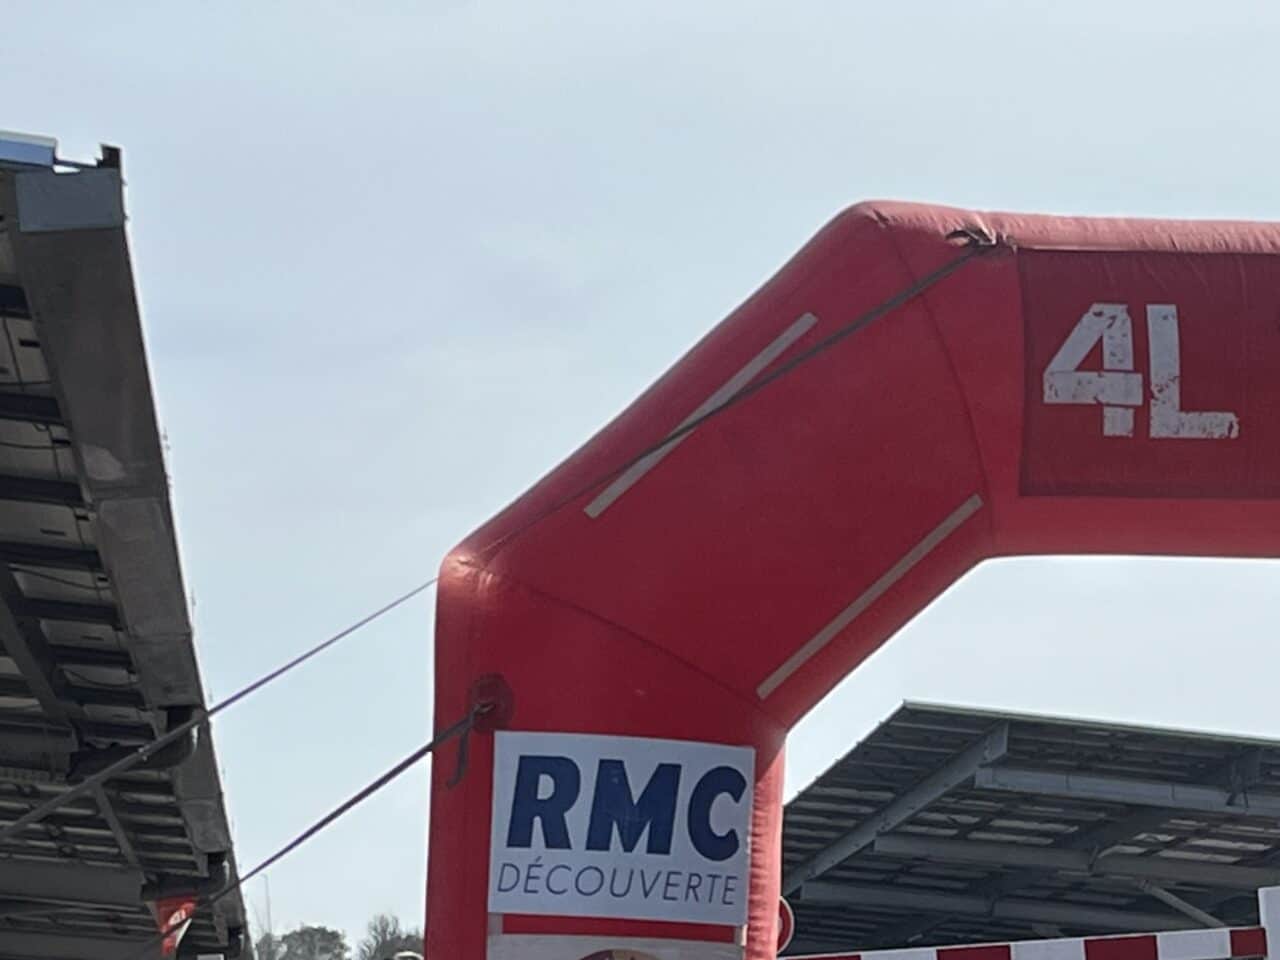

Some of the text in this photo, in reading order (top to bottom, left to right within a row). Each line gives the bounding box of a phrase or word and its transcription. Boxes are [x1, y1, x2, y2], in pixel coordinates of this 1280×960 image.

[1043, 303, 1240, 439] 4L
[506, 755, 747, 861] RMC
[497, 856, 739, 905] DÉCOUVERTE
